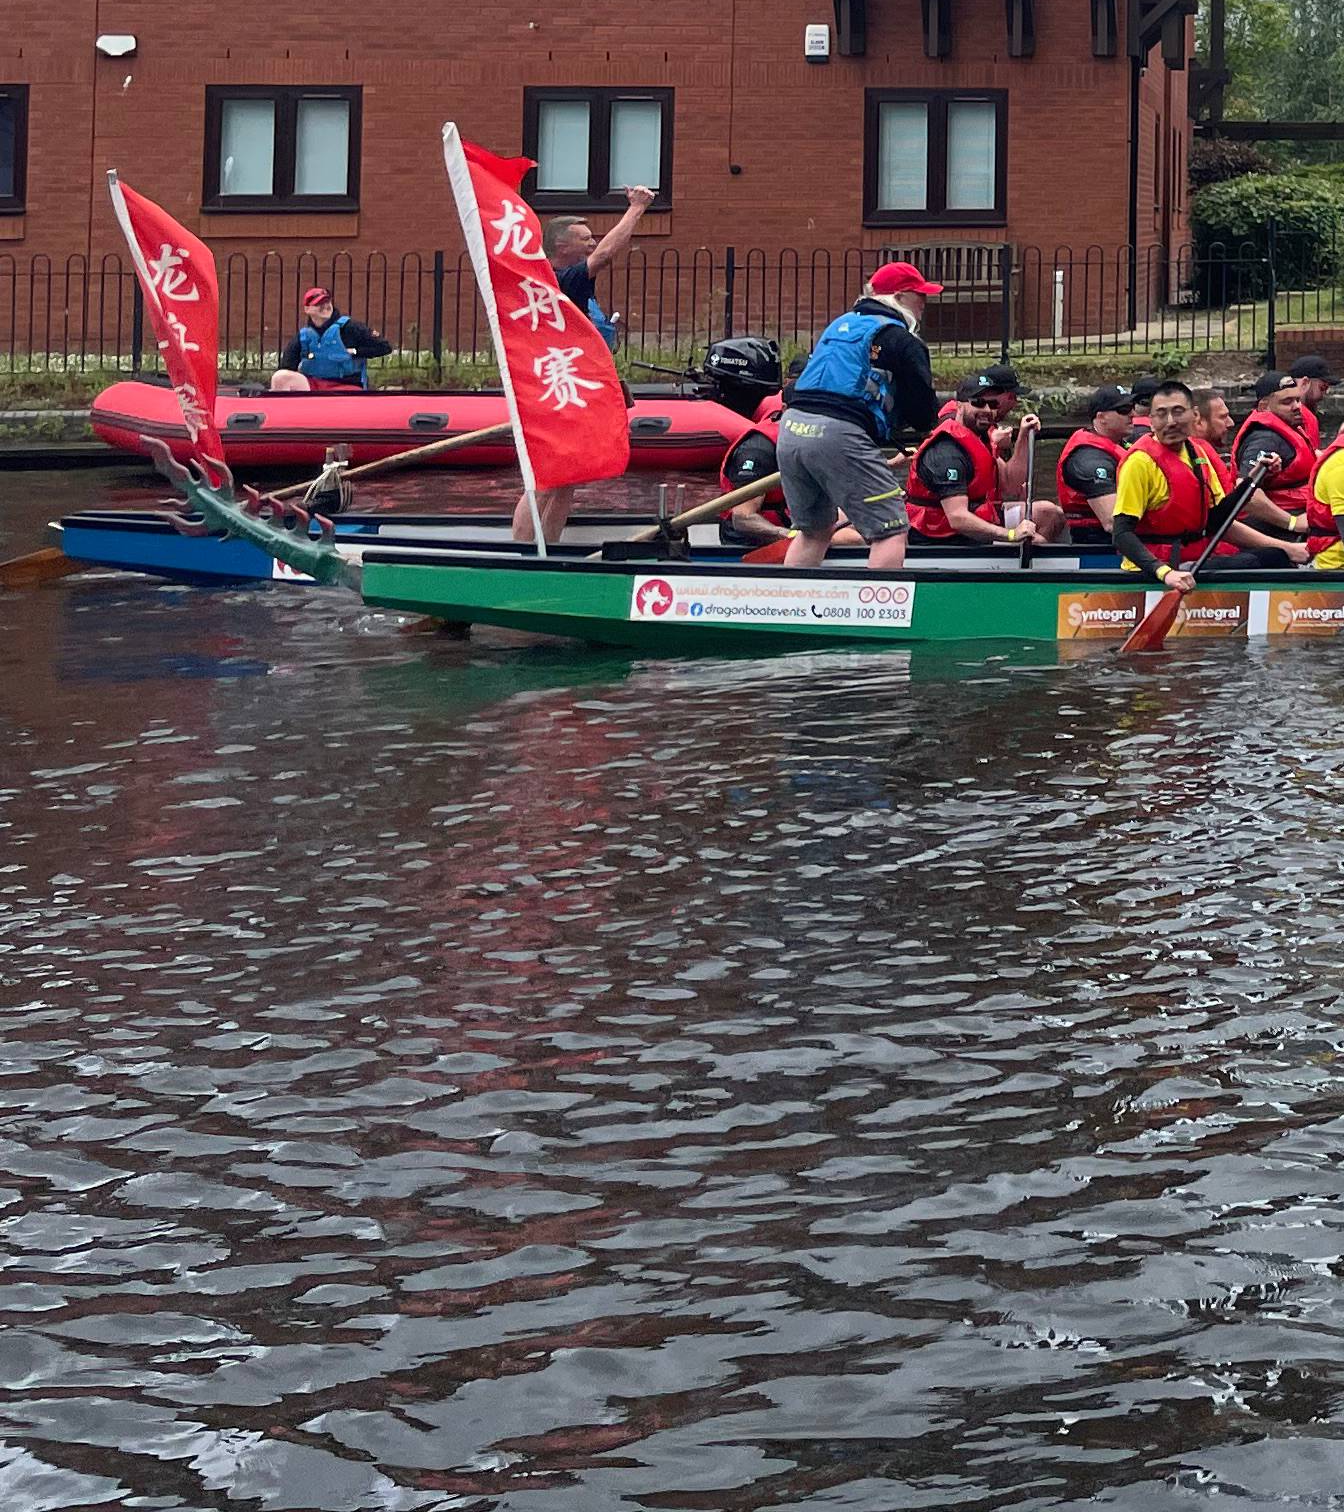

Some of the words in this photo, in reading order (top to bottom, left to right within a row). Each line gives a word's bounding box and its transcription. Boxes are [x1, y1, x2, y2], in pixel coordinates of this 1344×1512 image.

[489, 199, 605, 412] 龙舟赛
[676, 585, 849, 601] www.dragonboatevents.com
[704, 605, 807, 619] dragonboatevents
[823, 607, 851, 618] 0808
[856, 607, 875, 619] 100
[878, 608, 906, 620] 2303
[1068, 602, 1136, 626] Syntegral
